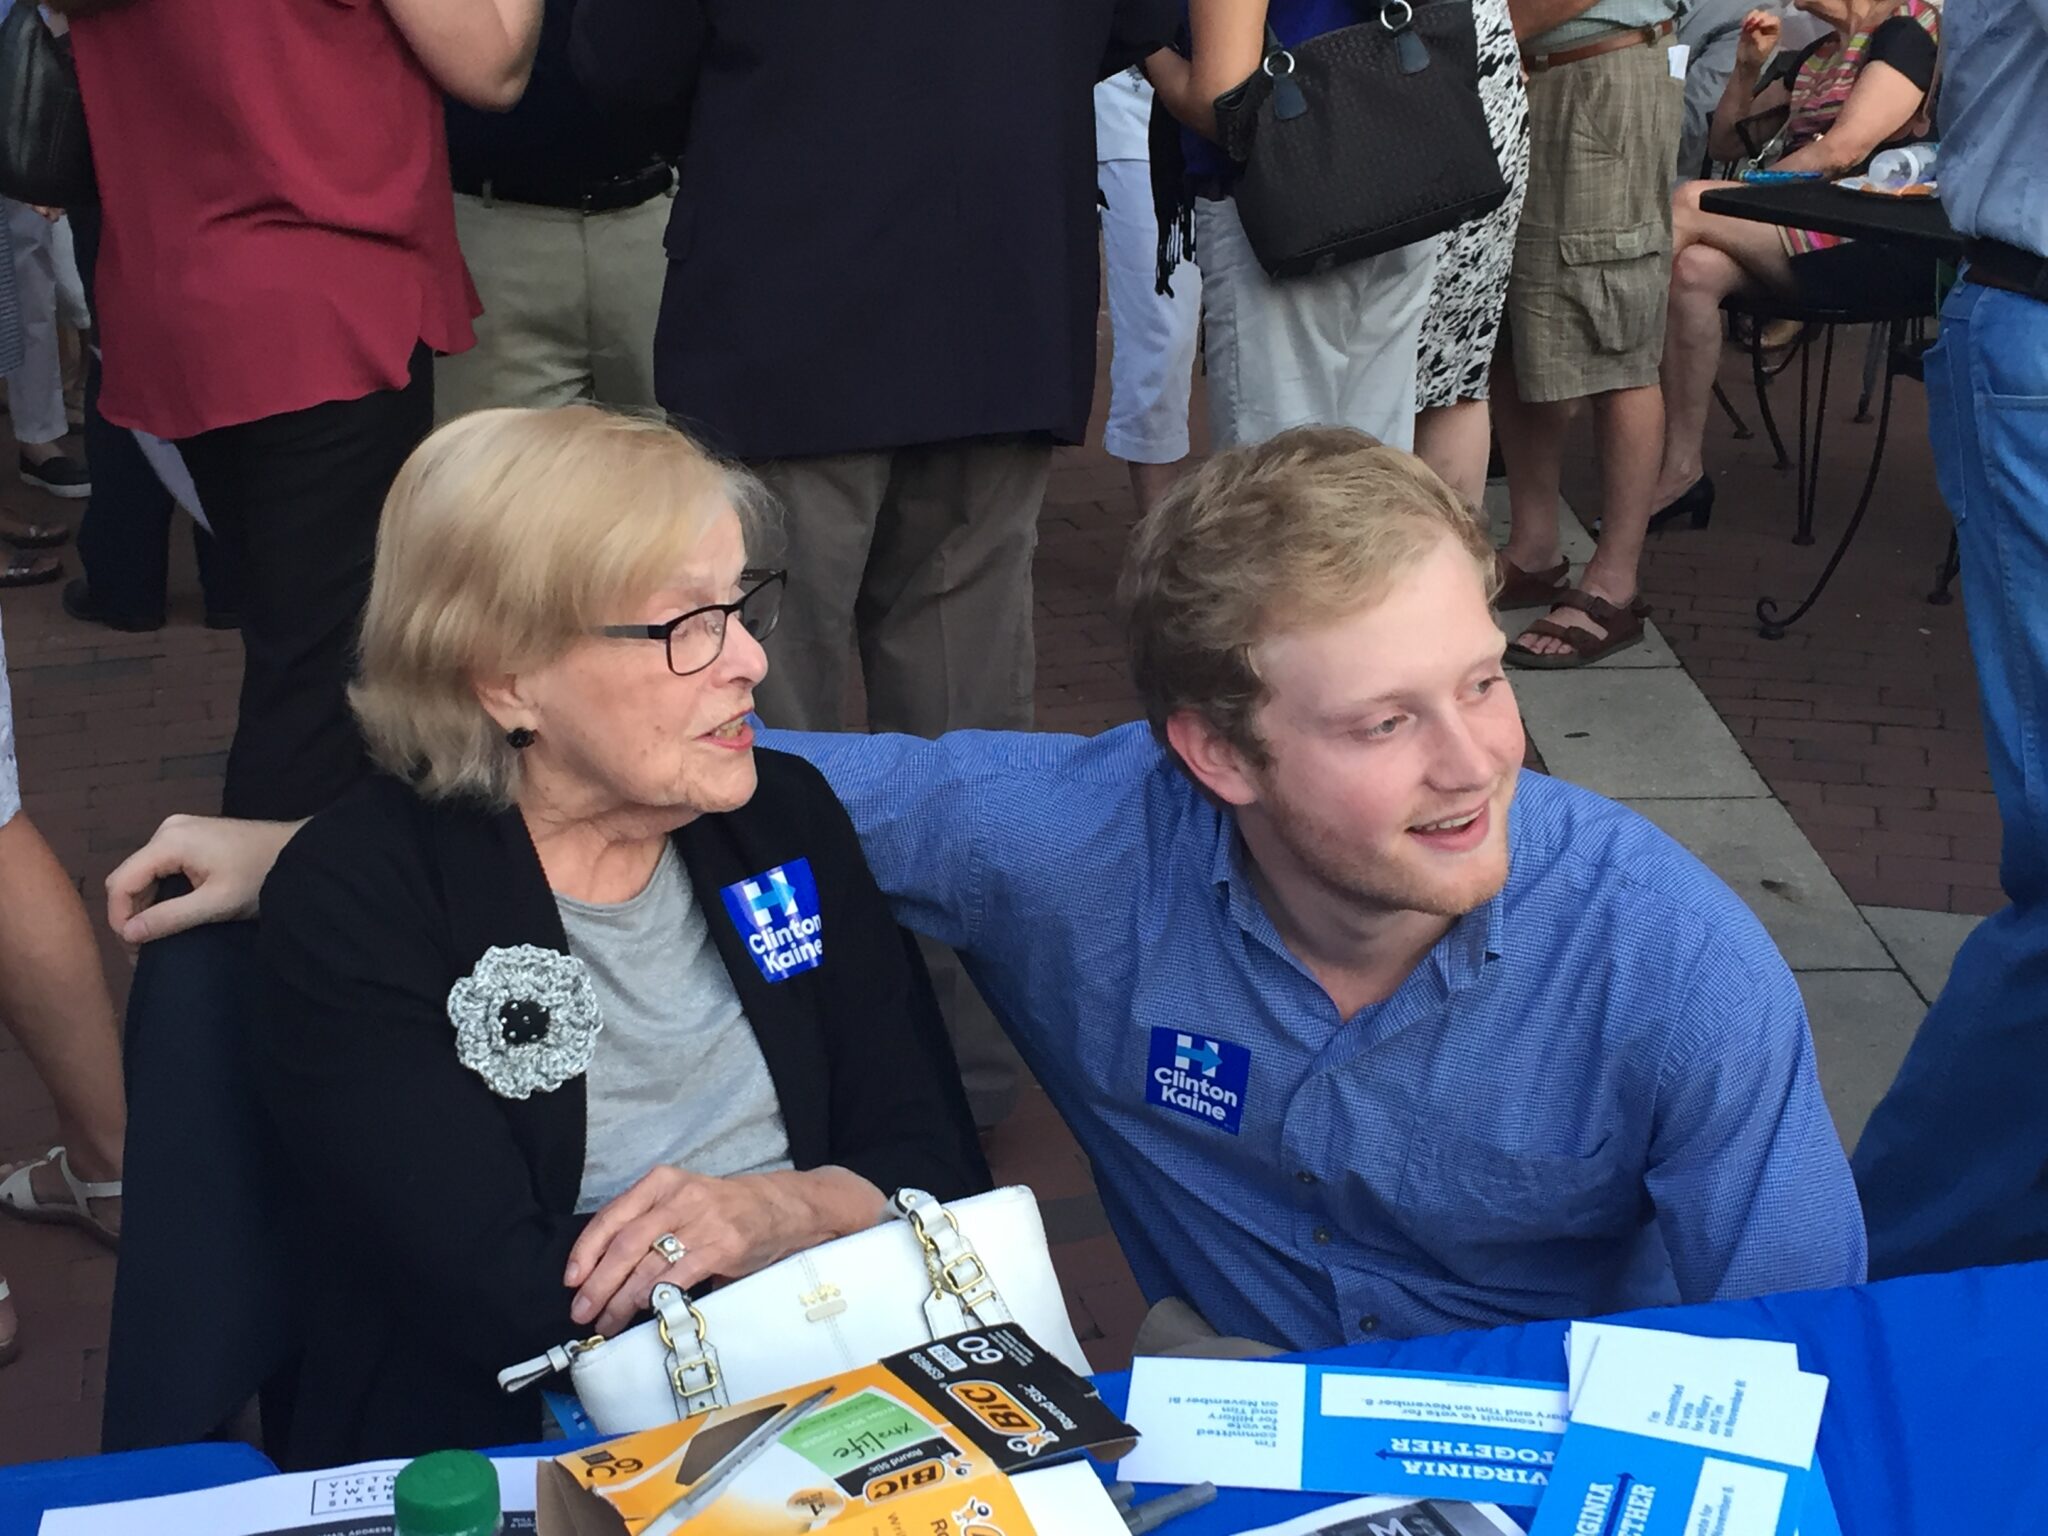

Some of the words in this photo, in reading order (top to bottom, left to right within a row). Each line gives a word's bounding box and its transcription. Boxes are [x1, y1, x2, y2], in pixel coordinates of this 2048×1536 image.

[748, 914, 822, 955] Clinton
[763, 938, 823, 974] Kaine
[1153, 1066, 1239, 1108] Clinton
[1160, 1085, 1227, 1121] Kaine
[957, 1335, 1004, 1364] 60
[1186, 1397, 1258, 1407] November
[1378, 1398, 1452, 1411] November
[1425, 1408, 1457, 1418] vote
[1505, 1408, 1534, 1417] and
[1038, 1401, 1078, 1431] Round
[1480, 1413, 1536, 1426] commit
[1196, 1428, 1277, 1438] committed
[889, 1447, 924, 1468] Round
[1390, 1437, 1556, 1462] TOGETHER
[866, 1461, 890, 1477] Stic
[1401, 1460, 1549, 1486] VIRGINIA
